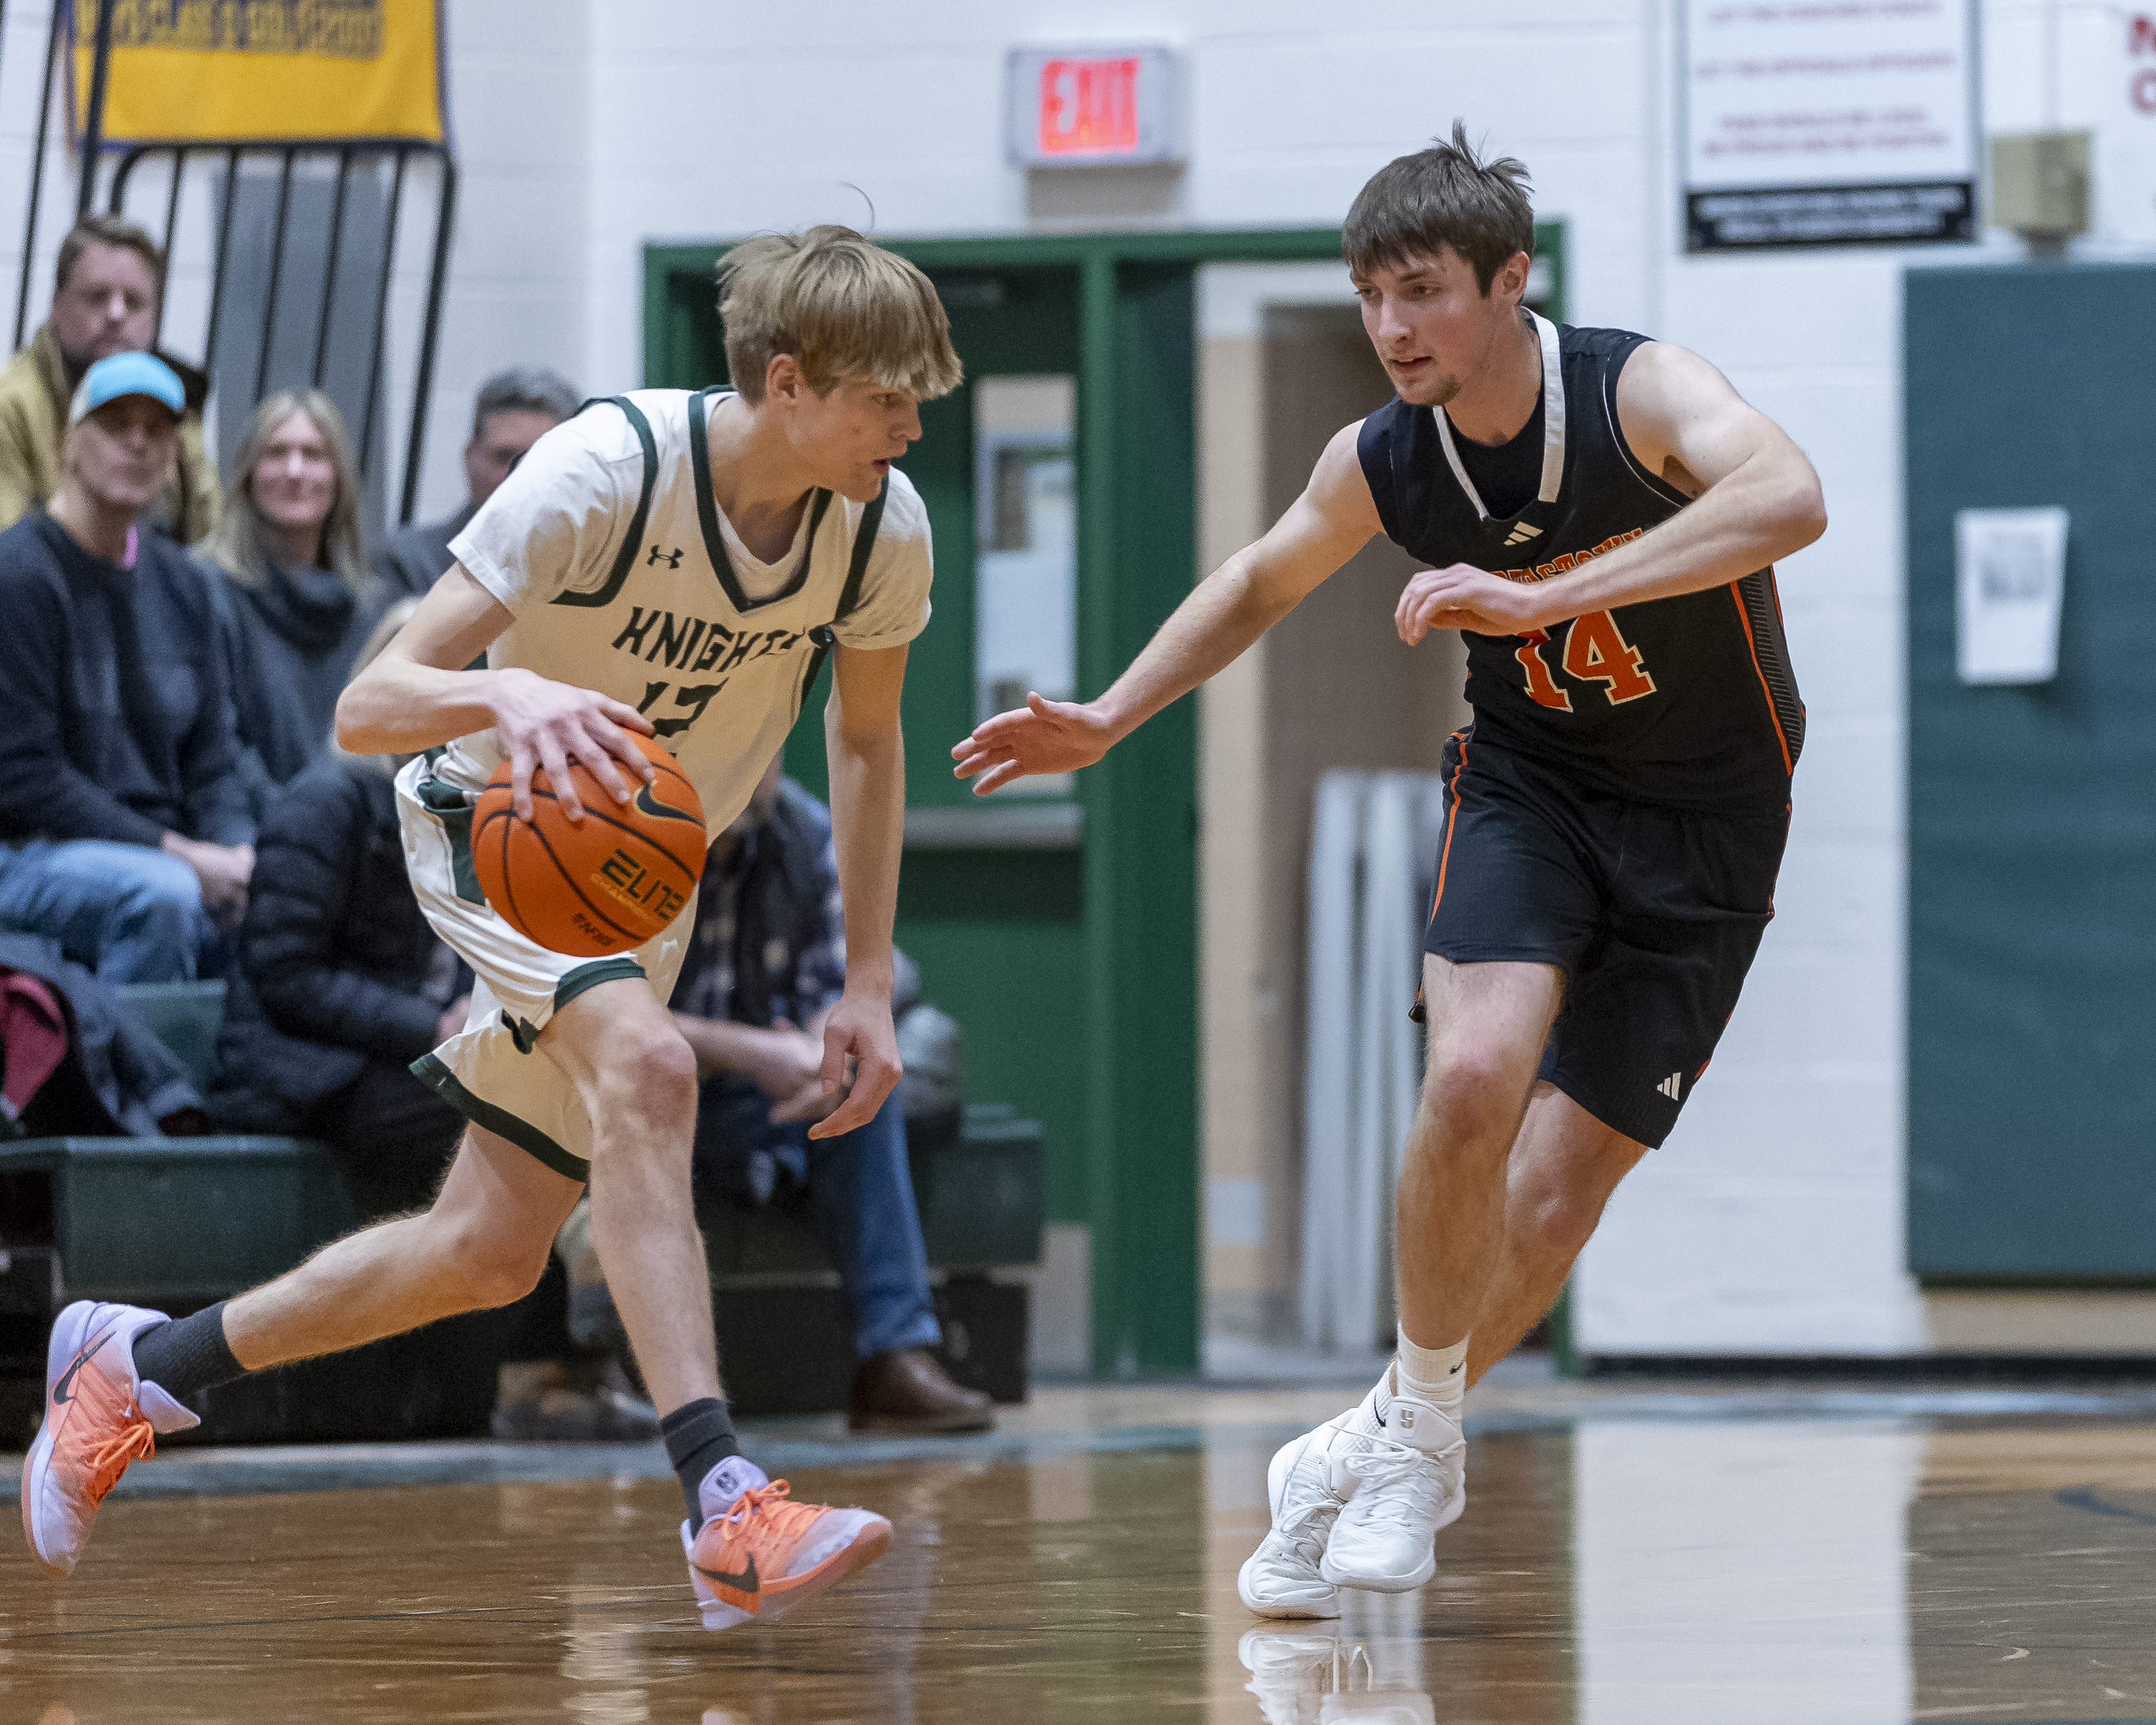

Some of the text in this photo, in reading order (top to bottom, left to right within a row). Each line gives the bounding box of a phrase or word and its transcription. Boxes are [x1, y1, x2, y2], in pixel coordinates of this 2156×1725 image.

[1038, 58, 1142, 154] EXIT
[1515, 611, 1657, 713] 14
[600, 847, 686, 921] ELITE
